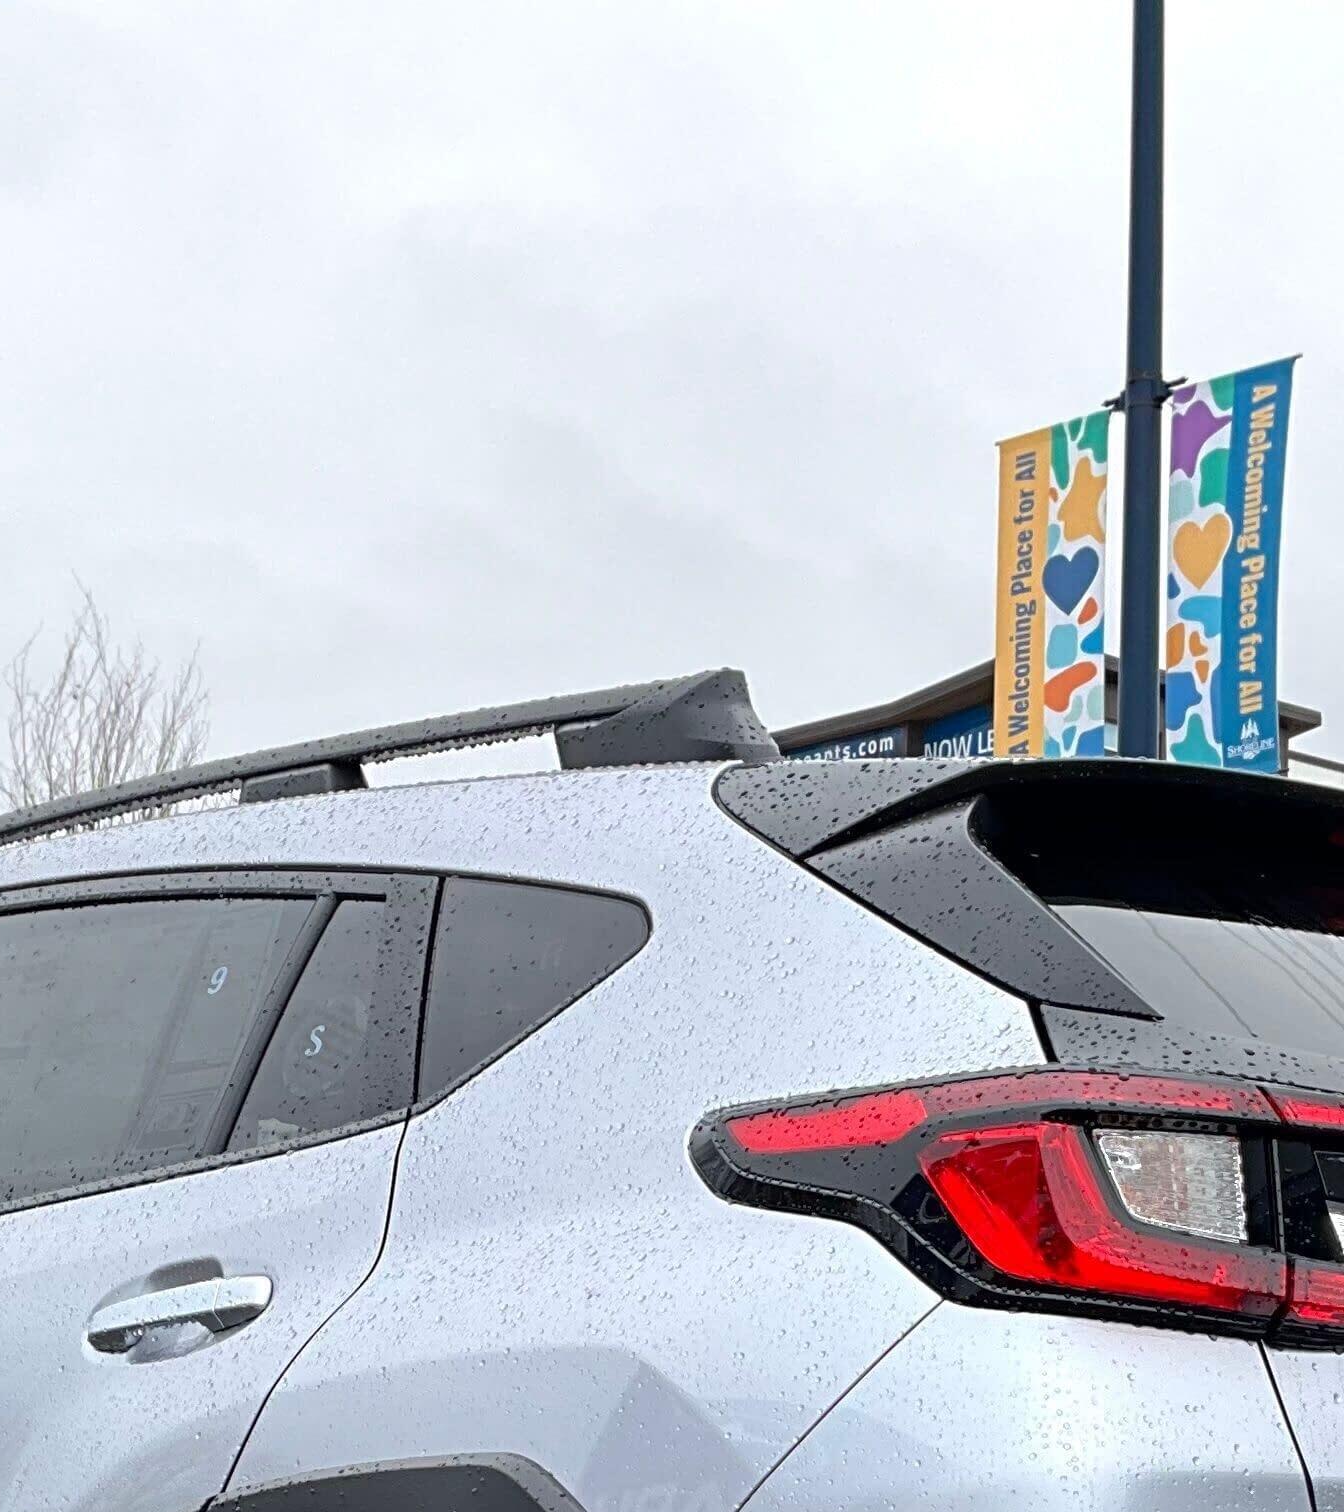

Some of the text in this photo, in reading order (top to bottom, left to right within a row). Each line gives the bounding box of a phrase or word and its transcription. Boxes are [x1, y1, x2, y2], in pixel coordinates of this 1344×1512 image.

[1008, 451, 1036, 755] A Welcoming Place for All
[1237, 384, 1277, 715] A Welcoming Place for All
[924, 729, 994, 759] NOW LE
